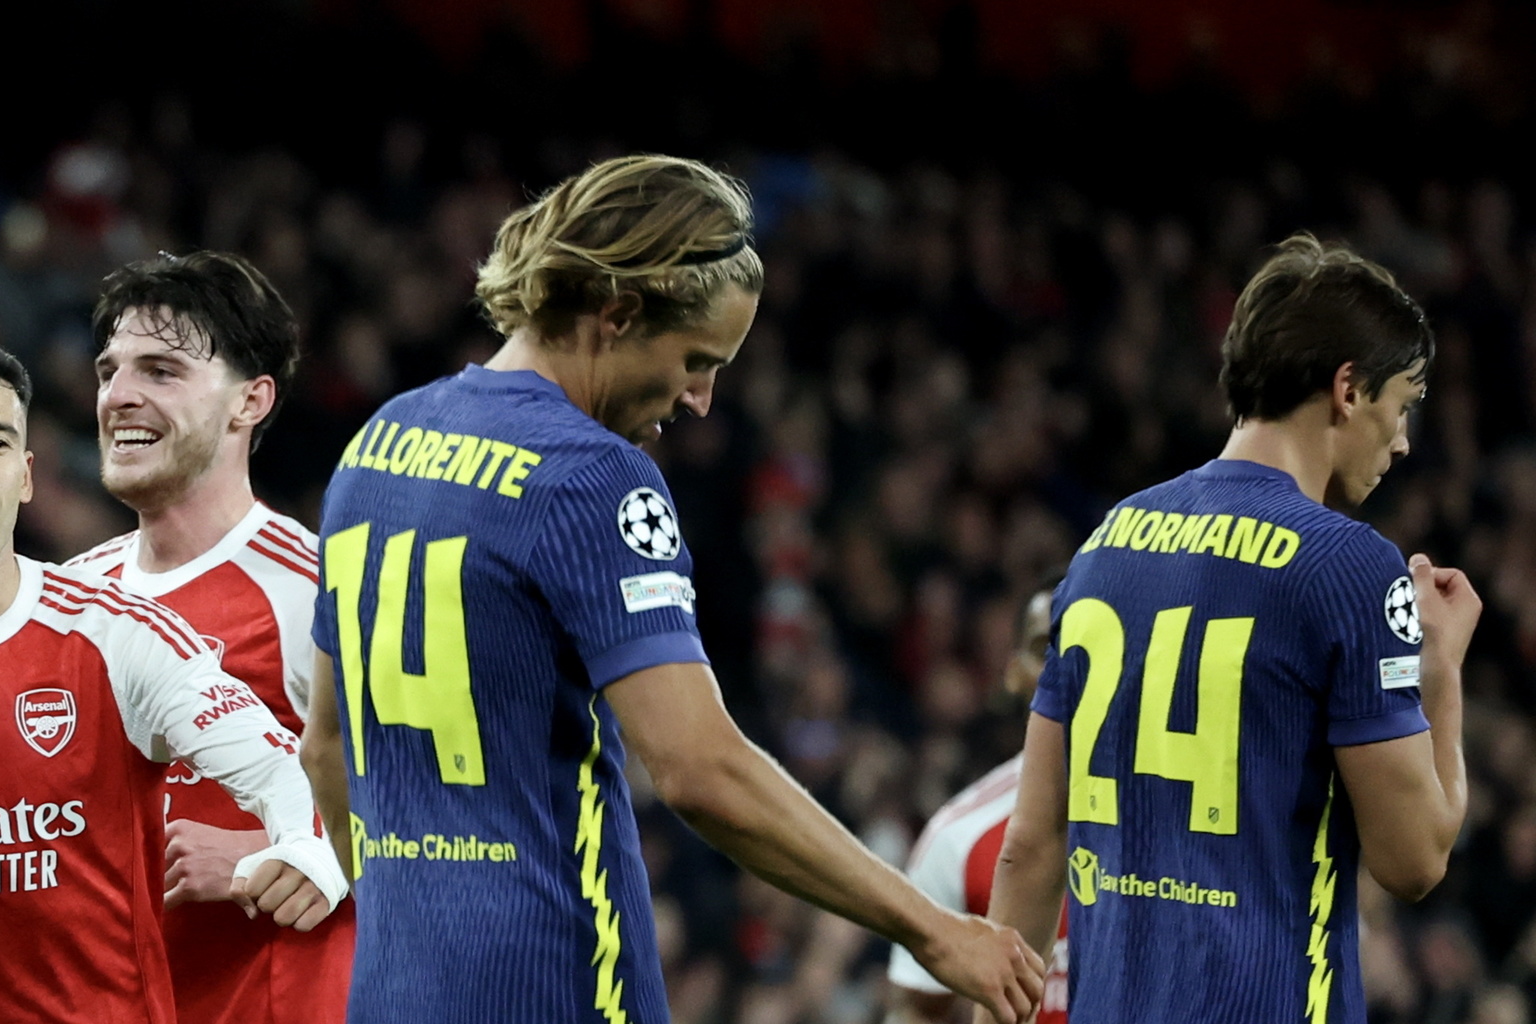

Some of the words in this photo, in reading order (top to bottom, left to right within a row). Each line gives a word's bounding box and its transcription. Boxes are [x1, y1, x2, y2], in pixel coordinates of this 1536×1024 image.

[1103, 506, 1301, 568] NORMAND
[325, 522, 485, 786] 14
[24, 699, 67, 712] Arsenal
[193, 694, 260, 731] RWAN
[1059, 598, 1254, 835] 24
[382, 832, 421, 860] the
[422, 833, 517, 862] Children
[1119, 873, 1157, 897] the
